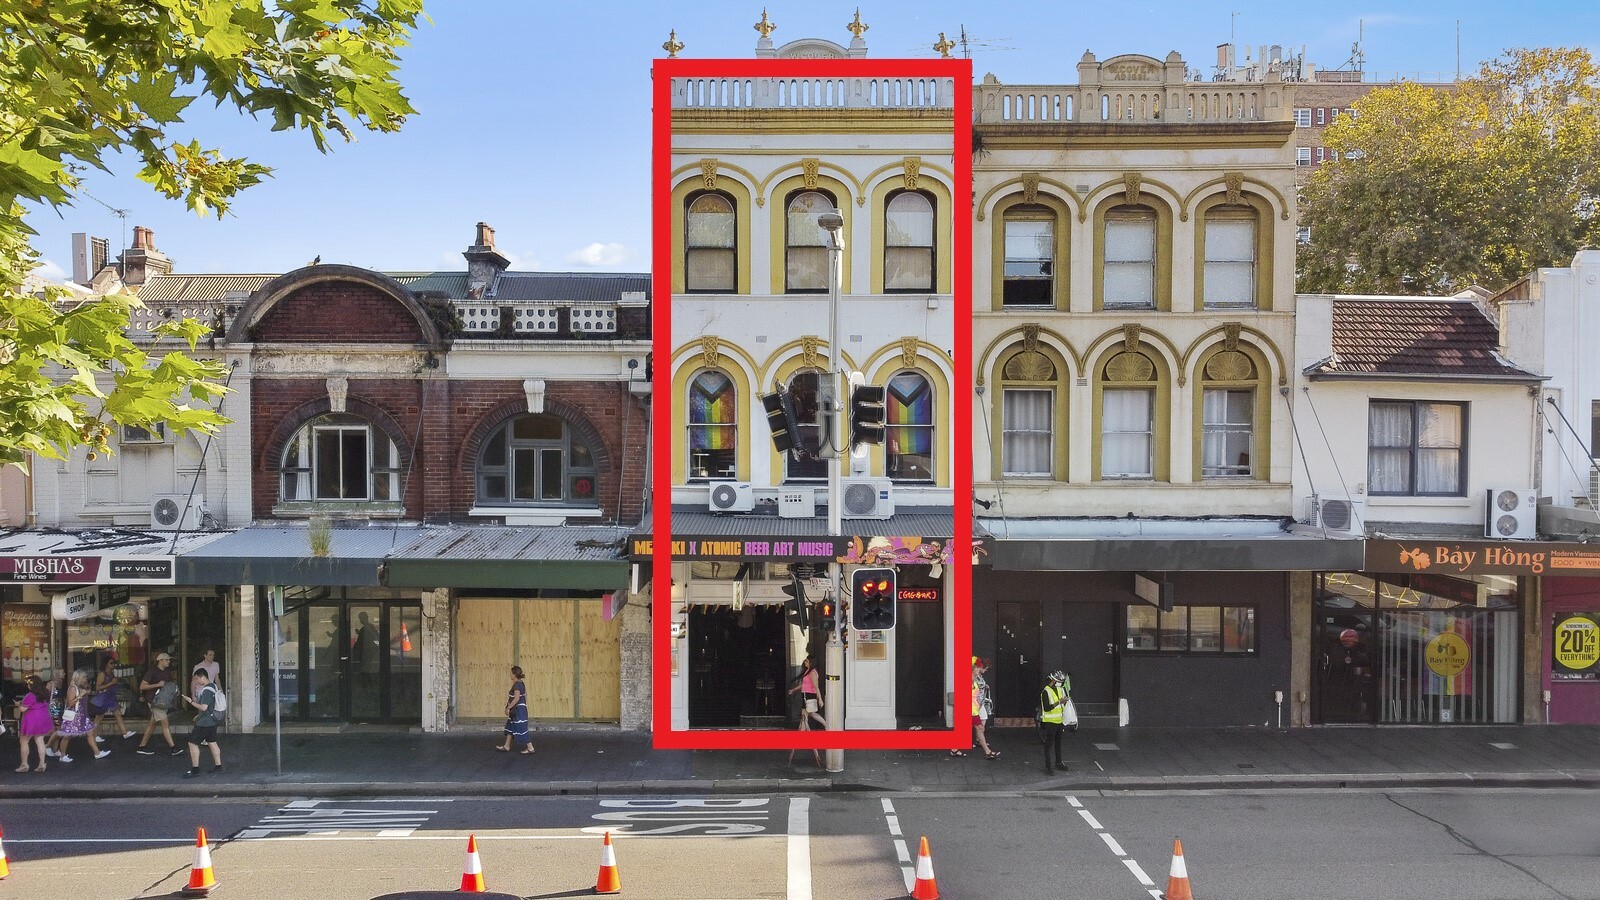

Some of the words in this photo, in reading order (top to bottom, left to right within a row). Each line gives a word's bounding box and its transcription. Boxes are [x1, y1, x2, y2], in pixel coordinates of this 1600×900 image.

[634, 540, 686, 555] MEKI
[689, 541, 696, 555] X
[700, 541, 742, 556] ATOMIC
[745, 541, 770, 556] BEER
[773, 542, 794, 556] ART
[798, 542, 833, 557] MUSIC
[14, 557, 84, 573] MISHA'S
[1435, 545, 1477, 571] Bảy
[1484, 546, 1545, 573] Hồng
[66, 593, 88, 605] BOTTLE
[69, 603, 85, 614] SHOP
[1584, 645, 1595, 653] OFF
[1560, 653, 1596, 661] EVERYTHING
[283, 672, 297, 680] sale
[580, 798, 770, 835] BUS
